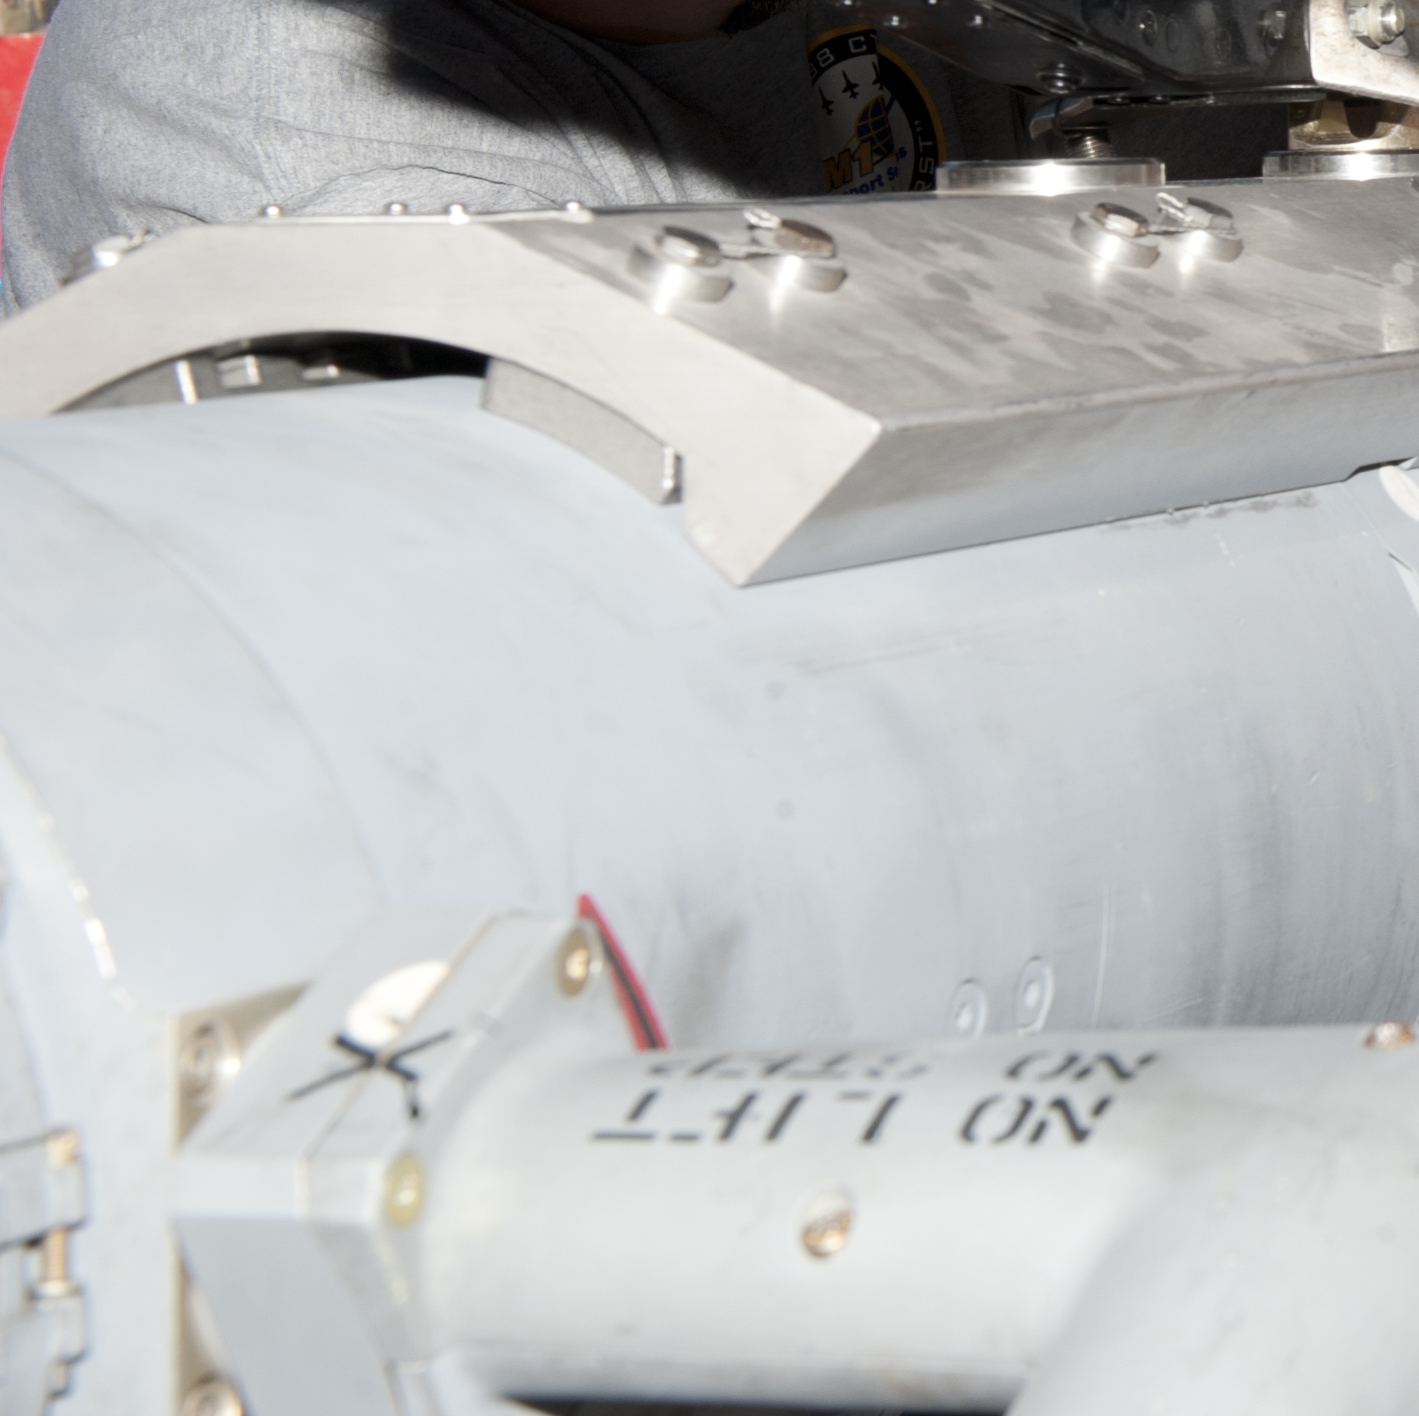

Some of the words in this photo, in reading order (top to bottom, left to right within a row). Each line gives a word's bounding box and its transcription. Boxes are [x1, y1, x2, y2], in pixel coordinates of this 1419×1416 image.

[1005, 1051, 1161, 1080] NO
[591, 1087, 902, 1144] LIFT
[959, 1093, 1113, 1144] NO
